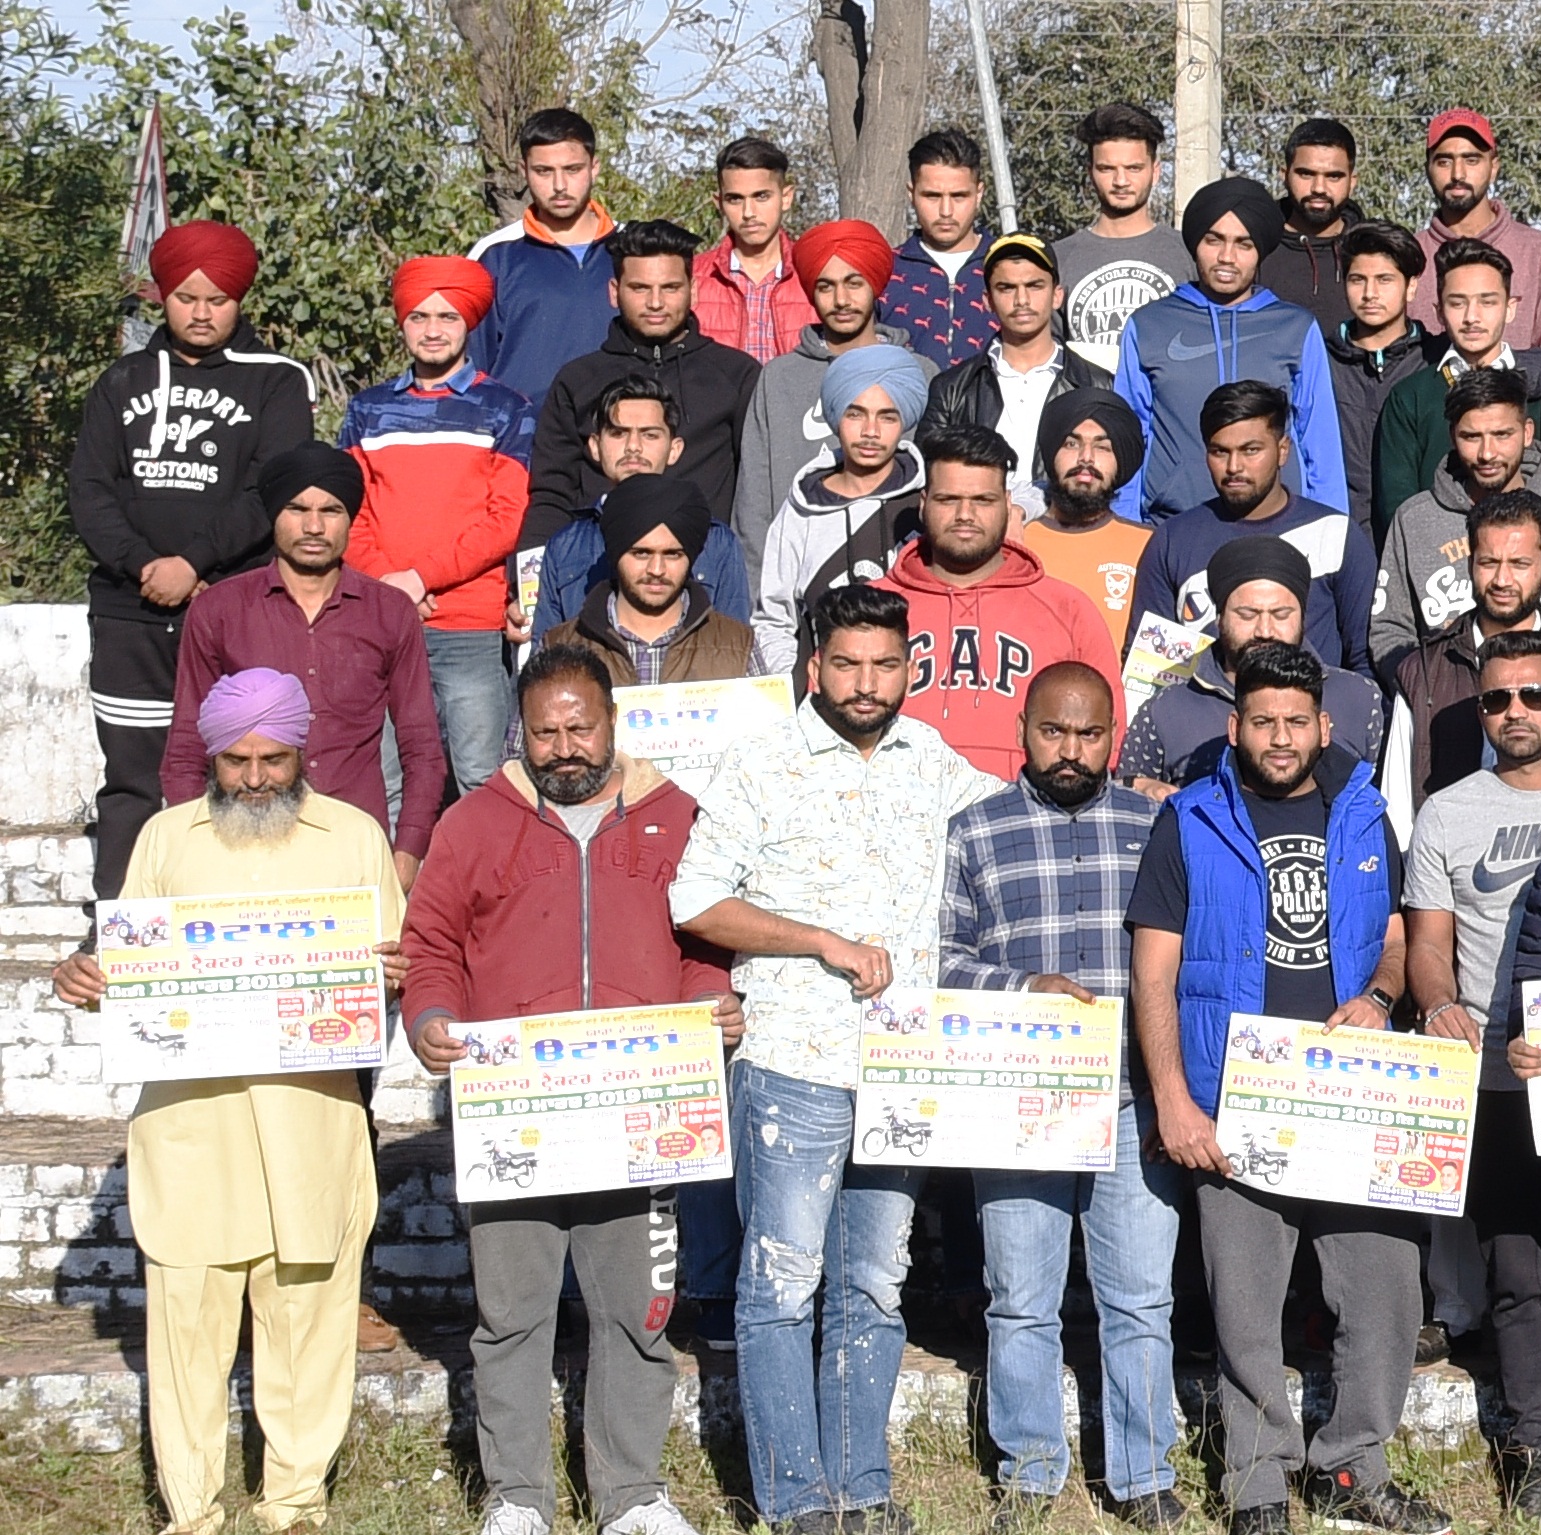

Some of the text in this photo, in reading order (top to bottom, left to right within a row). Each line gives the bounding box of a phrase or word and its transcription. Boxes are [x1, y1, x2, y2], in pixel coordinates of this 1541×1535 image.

[134, 460, 219, 484] CUSTOMS
[908, 626, 1033, 698] GAP
[1279, 871, 1320, 893] 883
[1271, 890, 1327, 915] POLIC
[150, 981, 179, 995] 10
[235, 974, 295, 990] 2019
[904, 1070, 932, 1083] 10
[983, 1072, 1037, 1086] 2019
[502, 1100, 530, 1114] 10
[584, 1092, 641, 1107] 2019
[1266, 1098, 1292, 1113] 10
[1343, 1108, 1394, 1125] 2019
